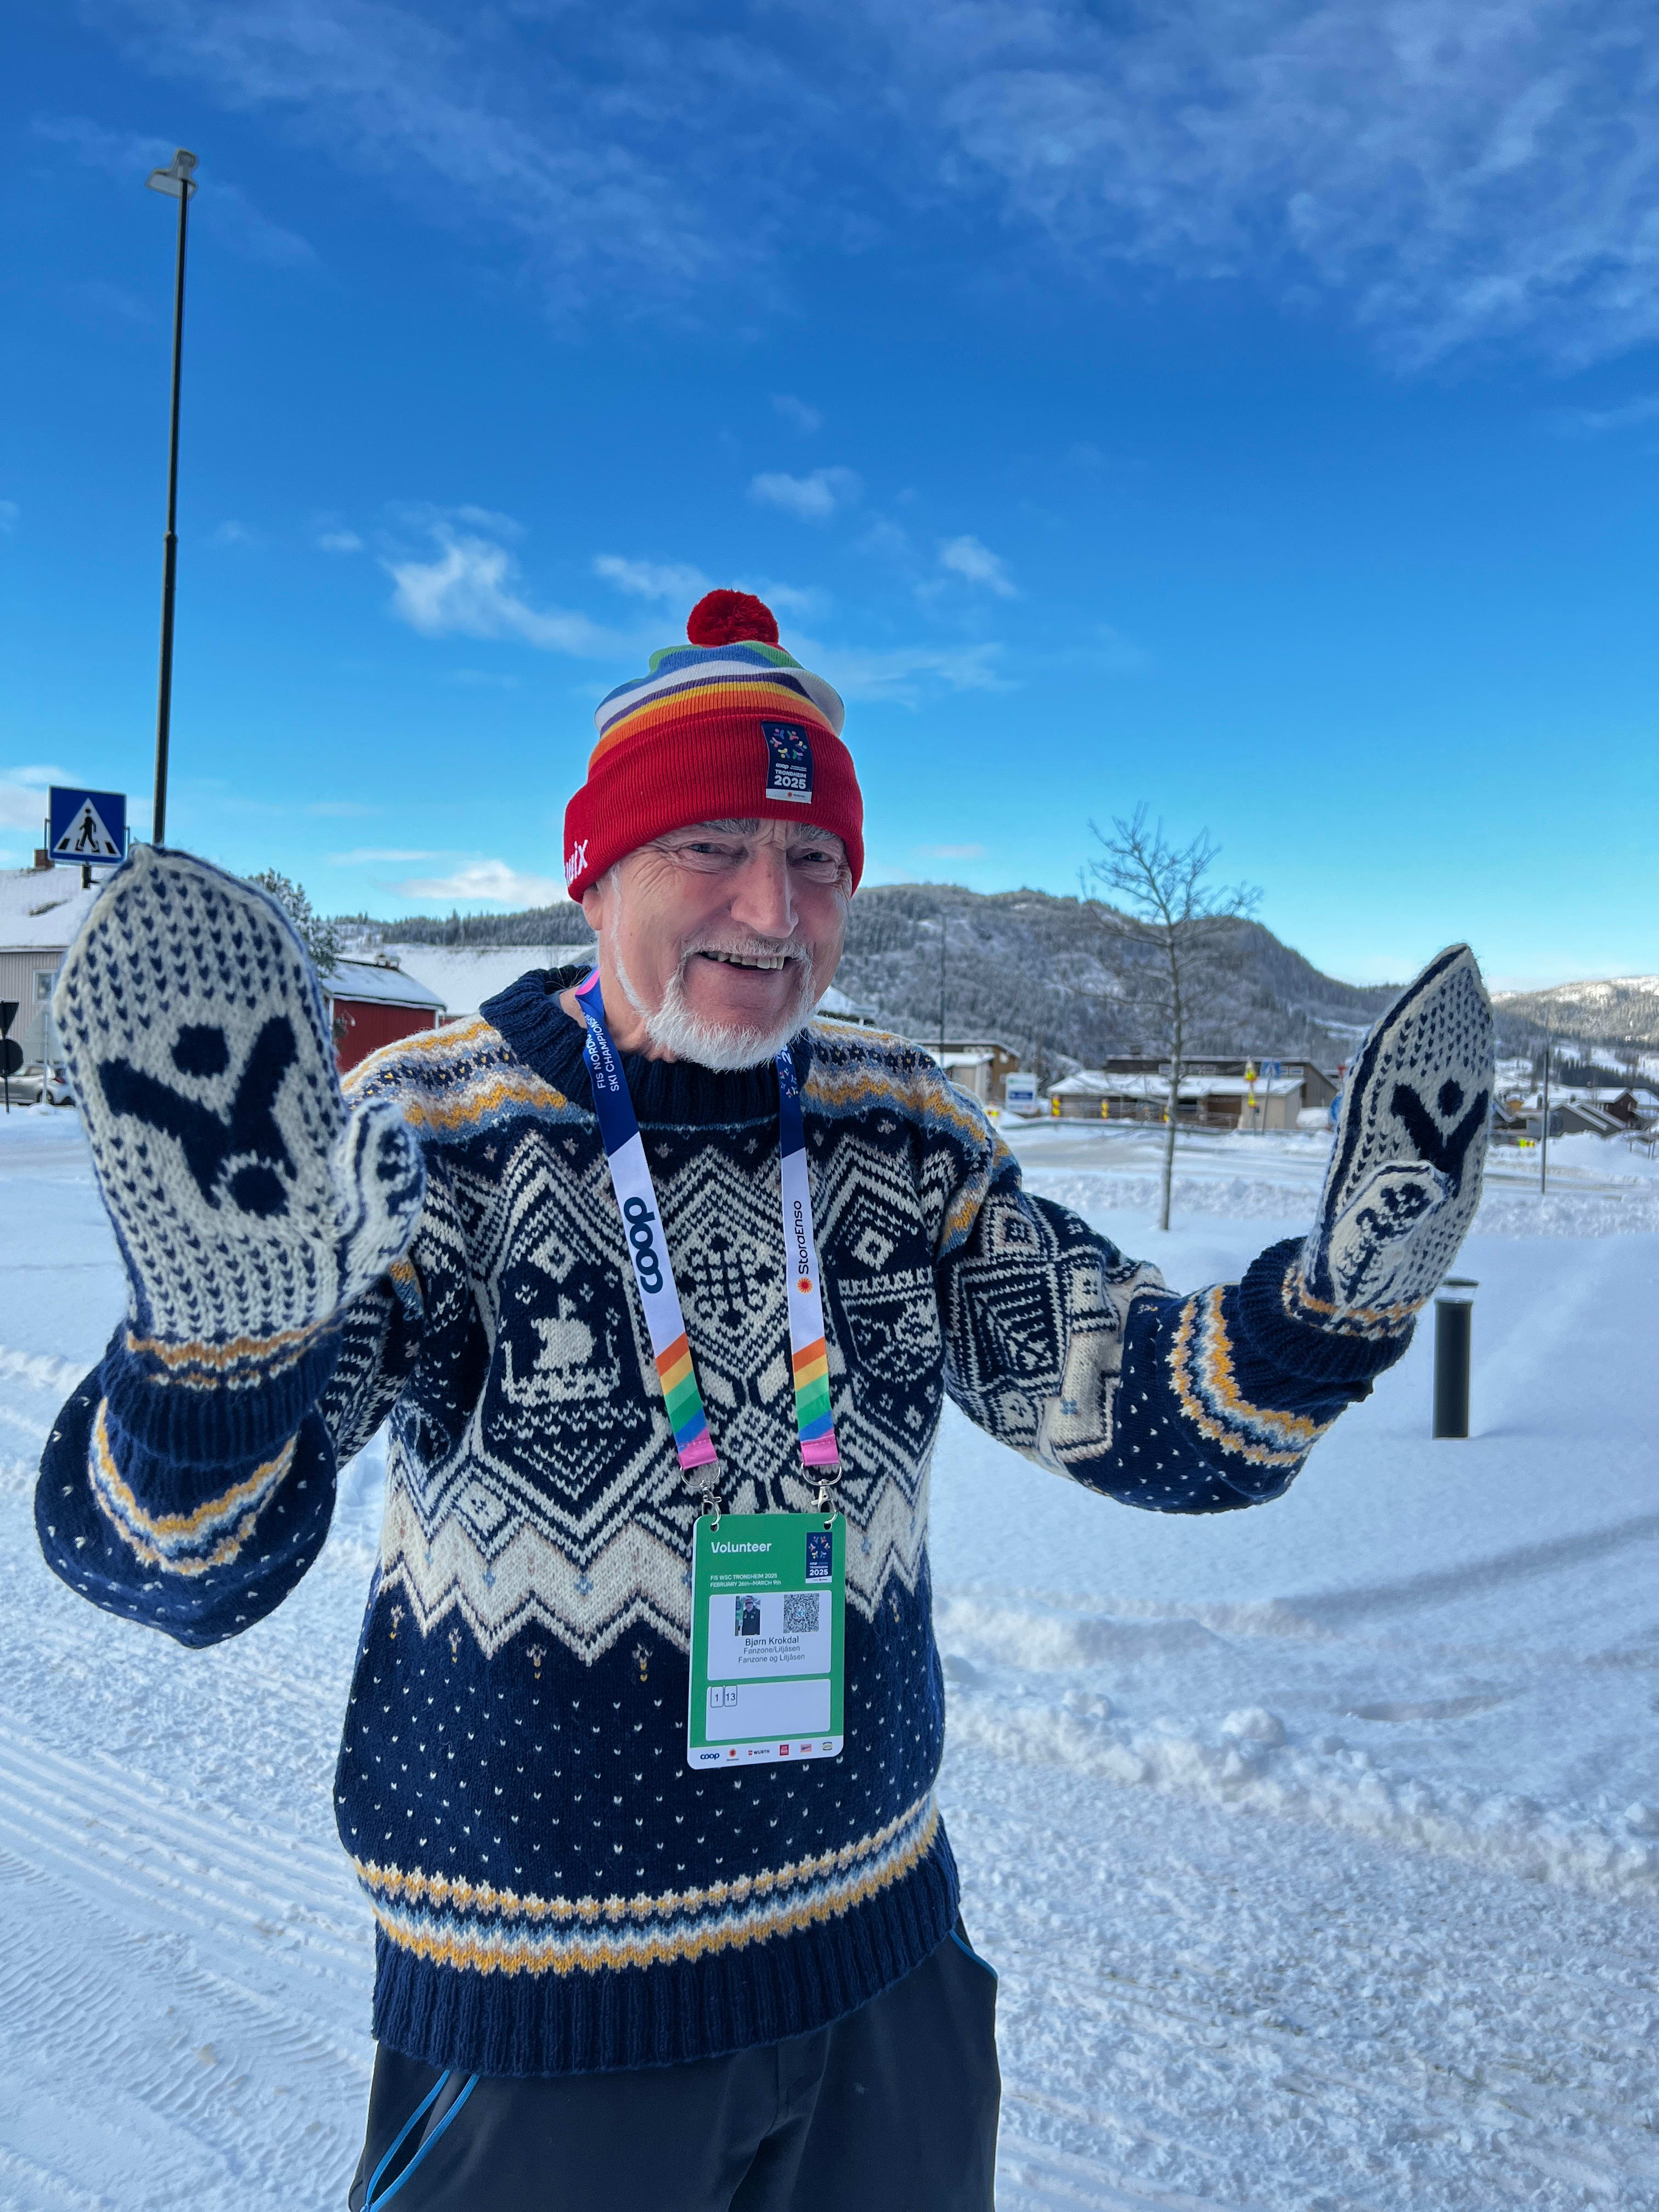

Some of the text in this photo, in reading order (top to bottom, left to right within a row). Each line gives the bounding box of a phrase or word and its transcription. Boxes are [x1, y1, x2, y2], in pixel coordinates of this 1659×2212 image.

[775, 769, 806, 778] TRONDHEIM
[774, 775, 806, 789] 2025
[586, 1034, 606, 1089] FIS NORDIC
[608, 1074, 619, 1092] SKI
[794, 1200, 809, 1274] StoraEnso
[624, 1197, 663, 1294] coop
[711, 1542, 772, 1554] Volunteer
[746, 1635, 799, 1647] Bjørn Krokdal
[780, 1654, 805, 1662] Litjåsen
[715, 1694, 719, 1702] 1
[726, 1692, 736, 1701] 13
